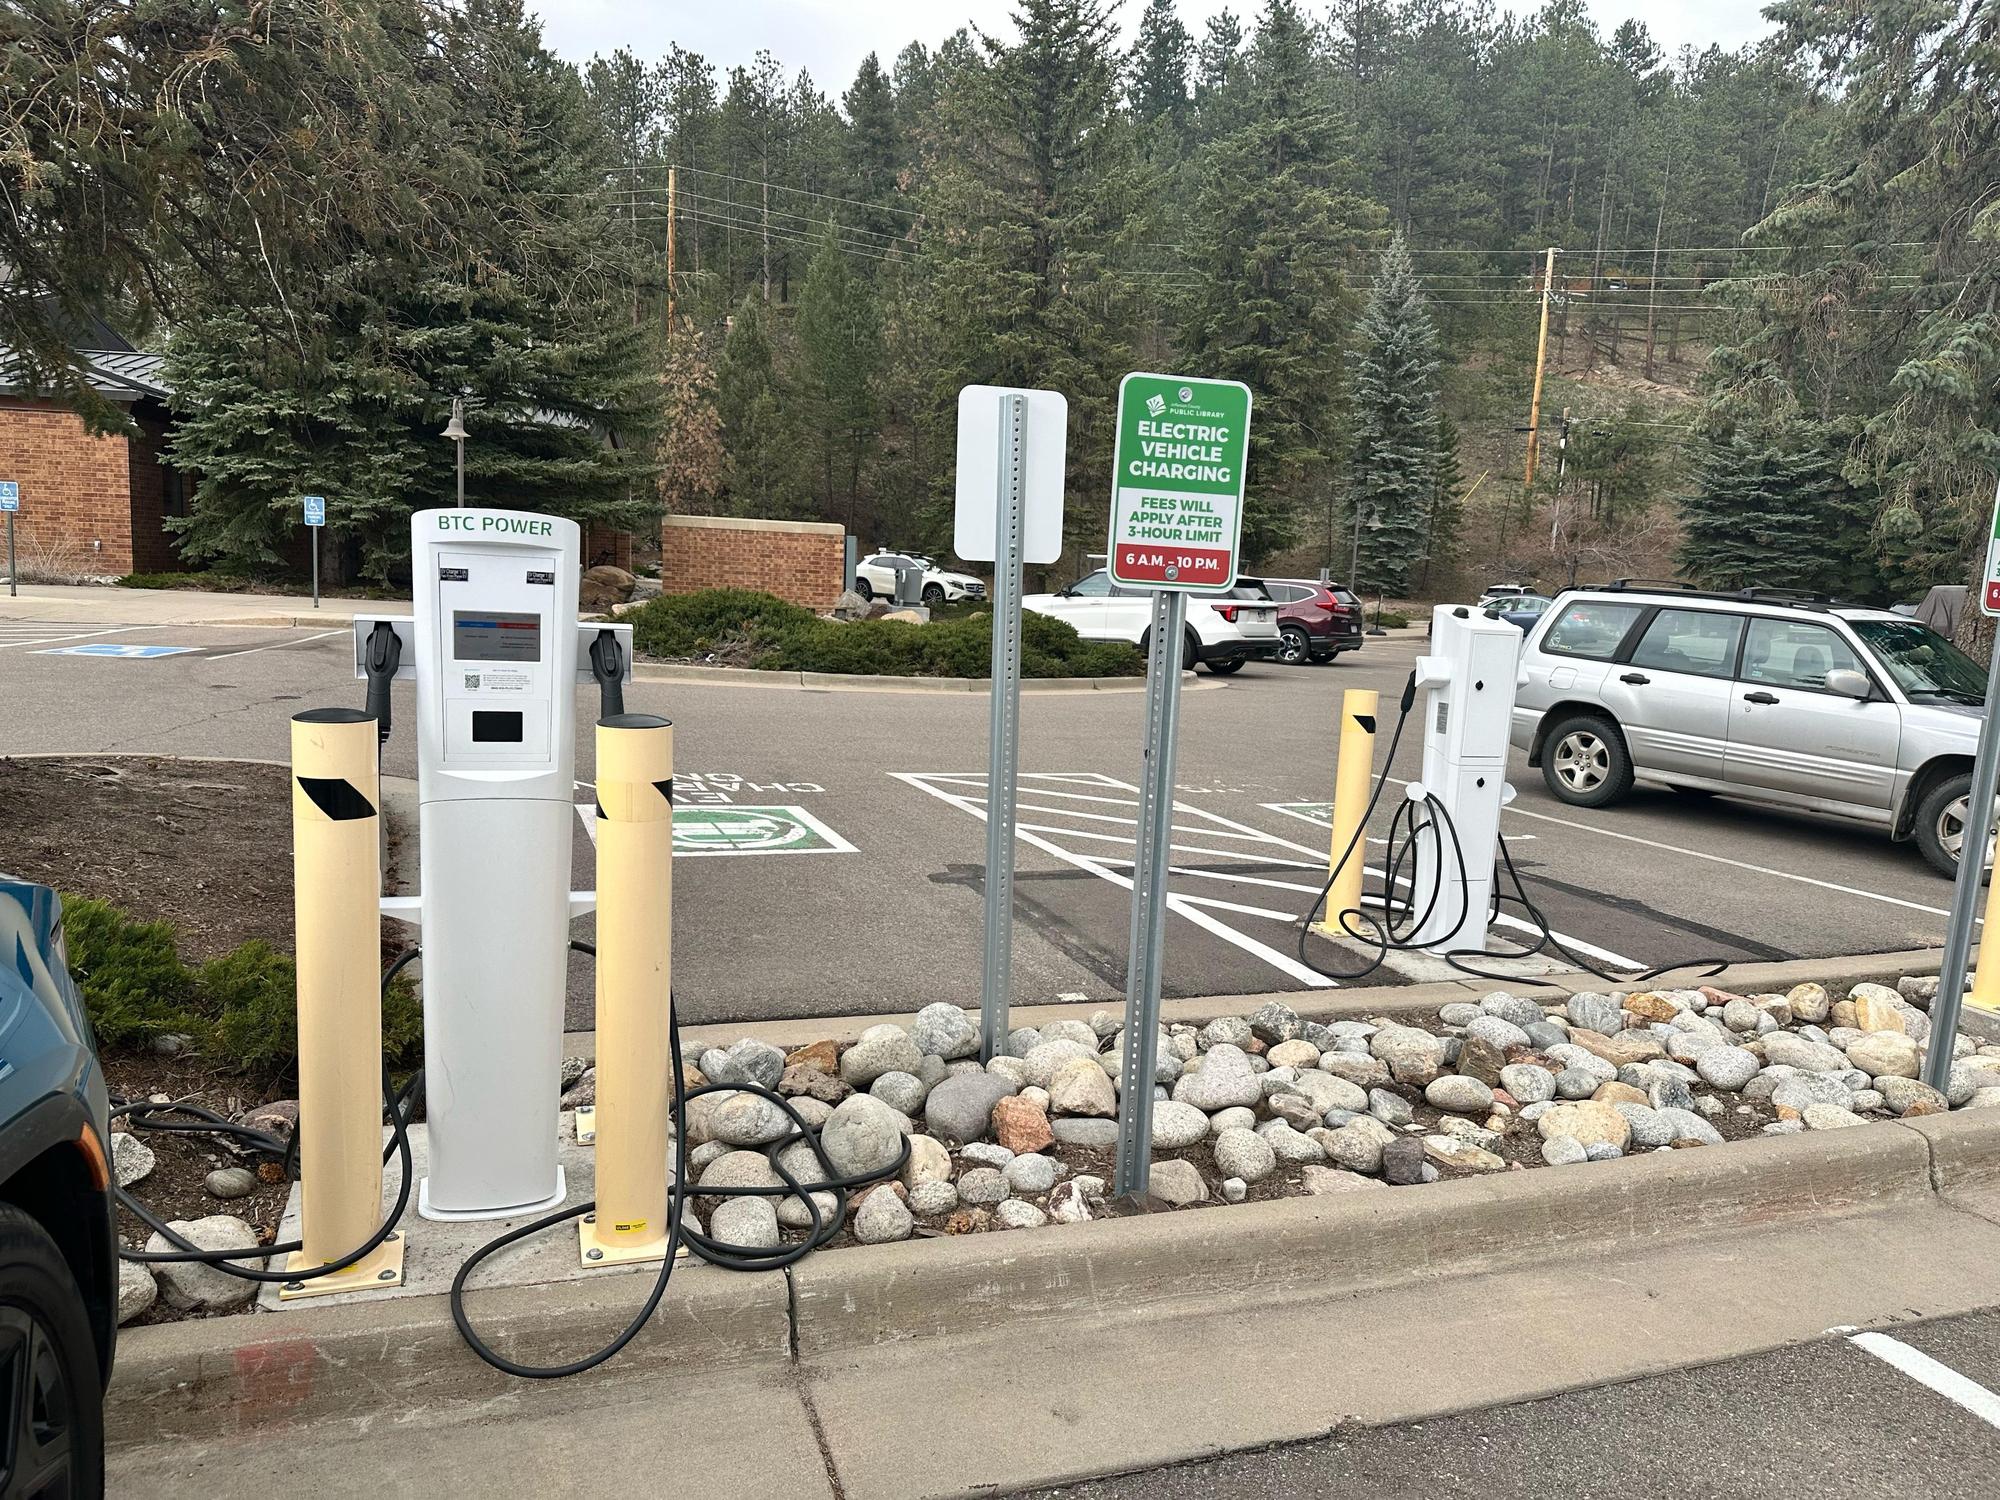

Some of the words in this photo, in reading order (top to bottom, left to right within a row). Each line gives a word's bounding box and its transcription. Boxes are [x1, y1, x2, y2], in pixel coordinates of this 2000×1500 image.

[1169, 408, 1195, 416] PUBLIC
[1196, 410, 1225, 418] LIBRARY
[1137, 420, 1230, 443] ELECTRIC
[1141, 441, 1223, 462] VEHICLE
[1129, 460, 1231, 483] CHARGING
[1141, 496, 1177, 510] FEES
[1180, 499, 1214, 513] WILL
[438, 515, 475, 531] BTC
[482, 517, 552, 536] POWER
[1128, 511, 1174, 525] APPLY
[1176, 514, 1223, 528] AFTER
[1128, 525, 1183, 540] 3-HOUR
[1185, 529, 1222, 543] LIMIT
[1125, 553, 1135, 565] 6
[1137, 554, 1166, 567] A.M.
[1176, 556, 1192, 569] 10
[1195, 558, 1220, 570] P.M.
